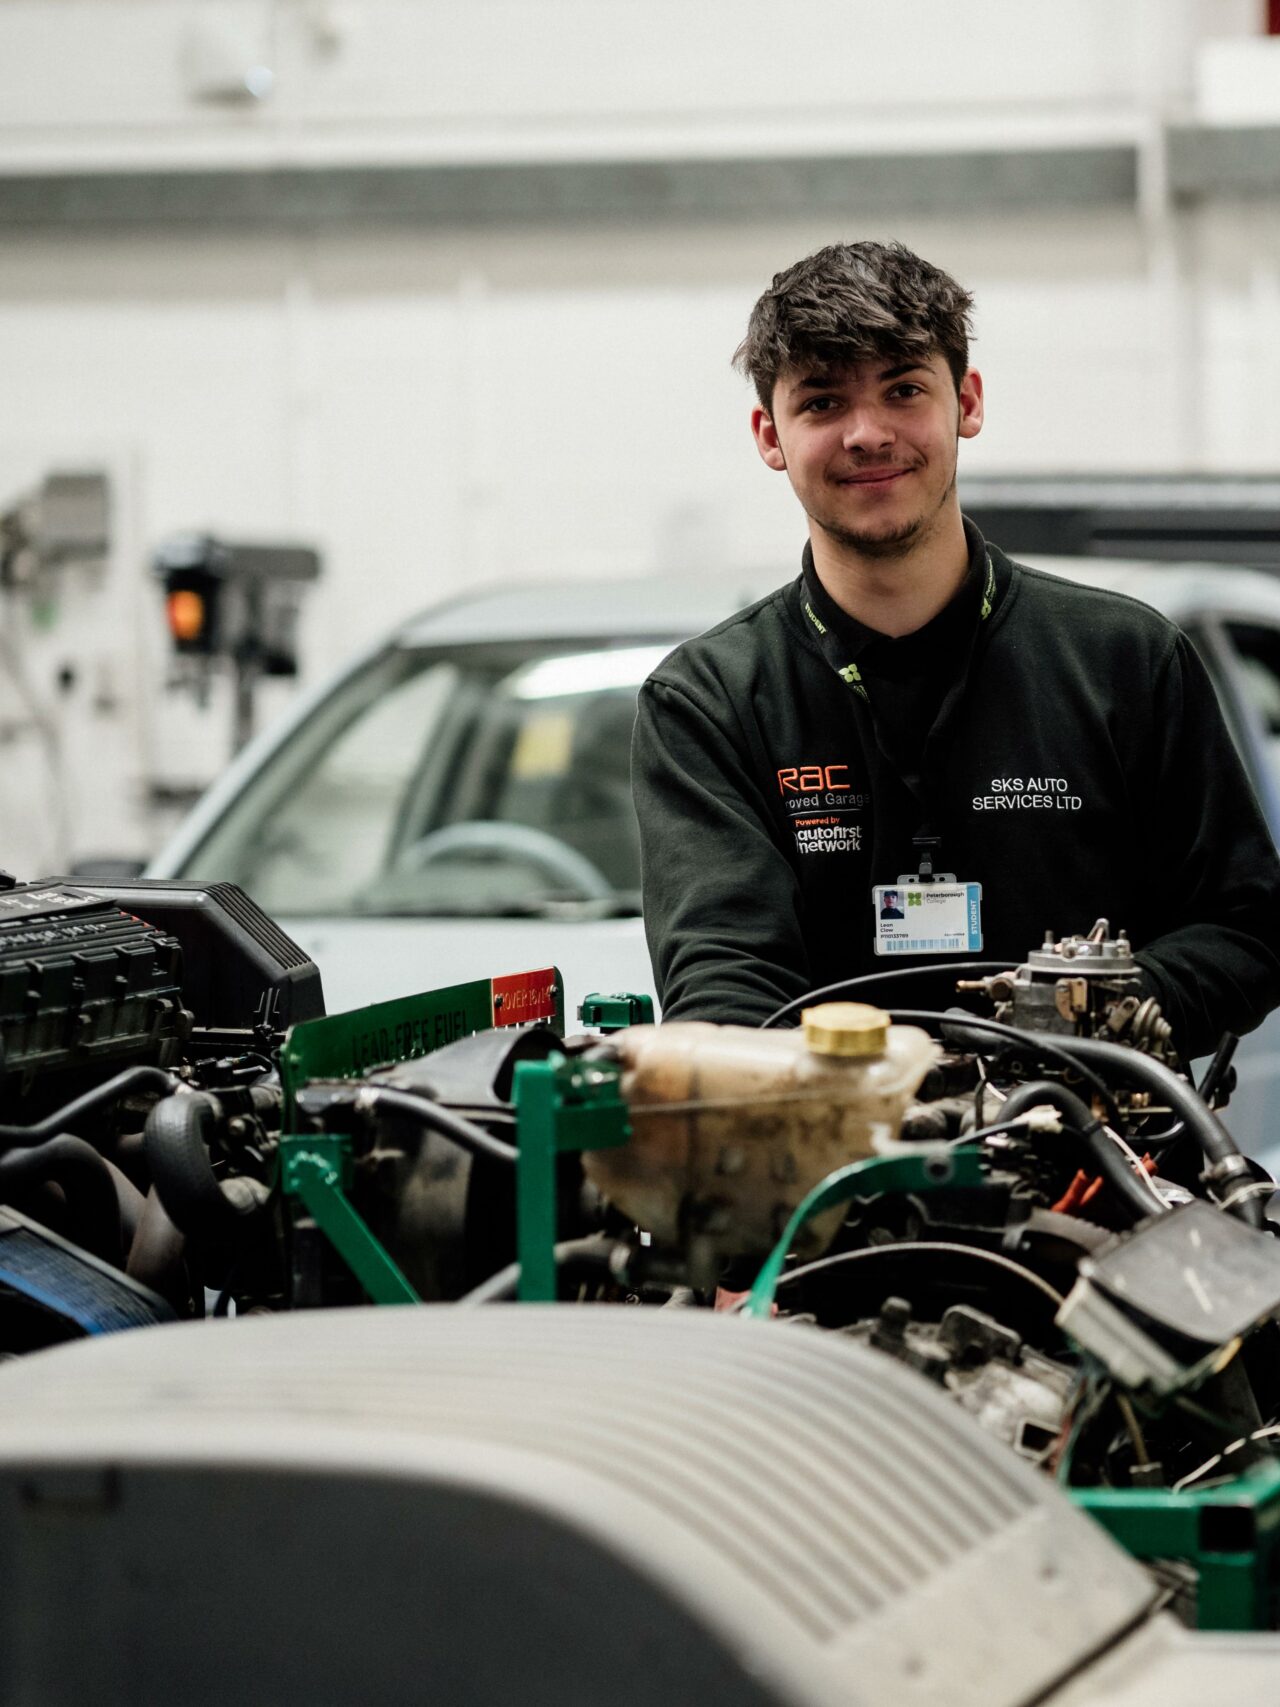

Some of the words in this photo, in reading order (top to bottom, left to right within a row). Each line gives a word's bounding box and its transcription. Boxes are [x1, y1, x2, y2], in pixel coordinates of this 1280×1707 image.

[805, 602, 827, 634] STUDENT
[991, 778, 1024, 792] SKS
[1027, 777, 1068, 792] AUTO
[972, 794, 1053, 810] SERVICES
[1056, 795, 1082, 810] LTD
[795, 817, 829, 827] Powered
[830, 816, 840, 824] by
[797, 826, 862, 841] autofirst
[798, 838, 861, 854] network
[353, 1018, 431, 1069] LEAD-FREE
